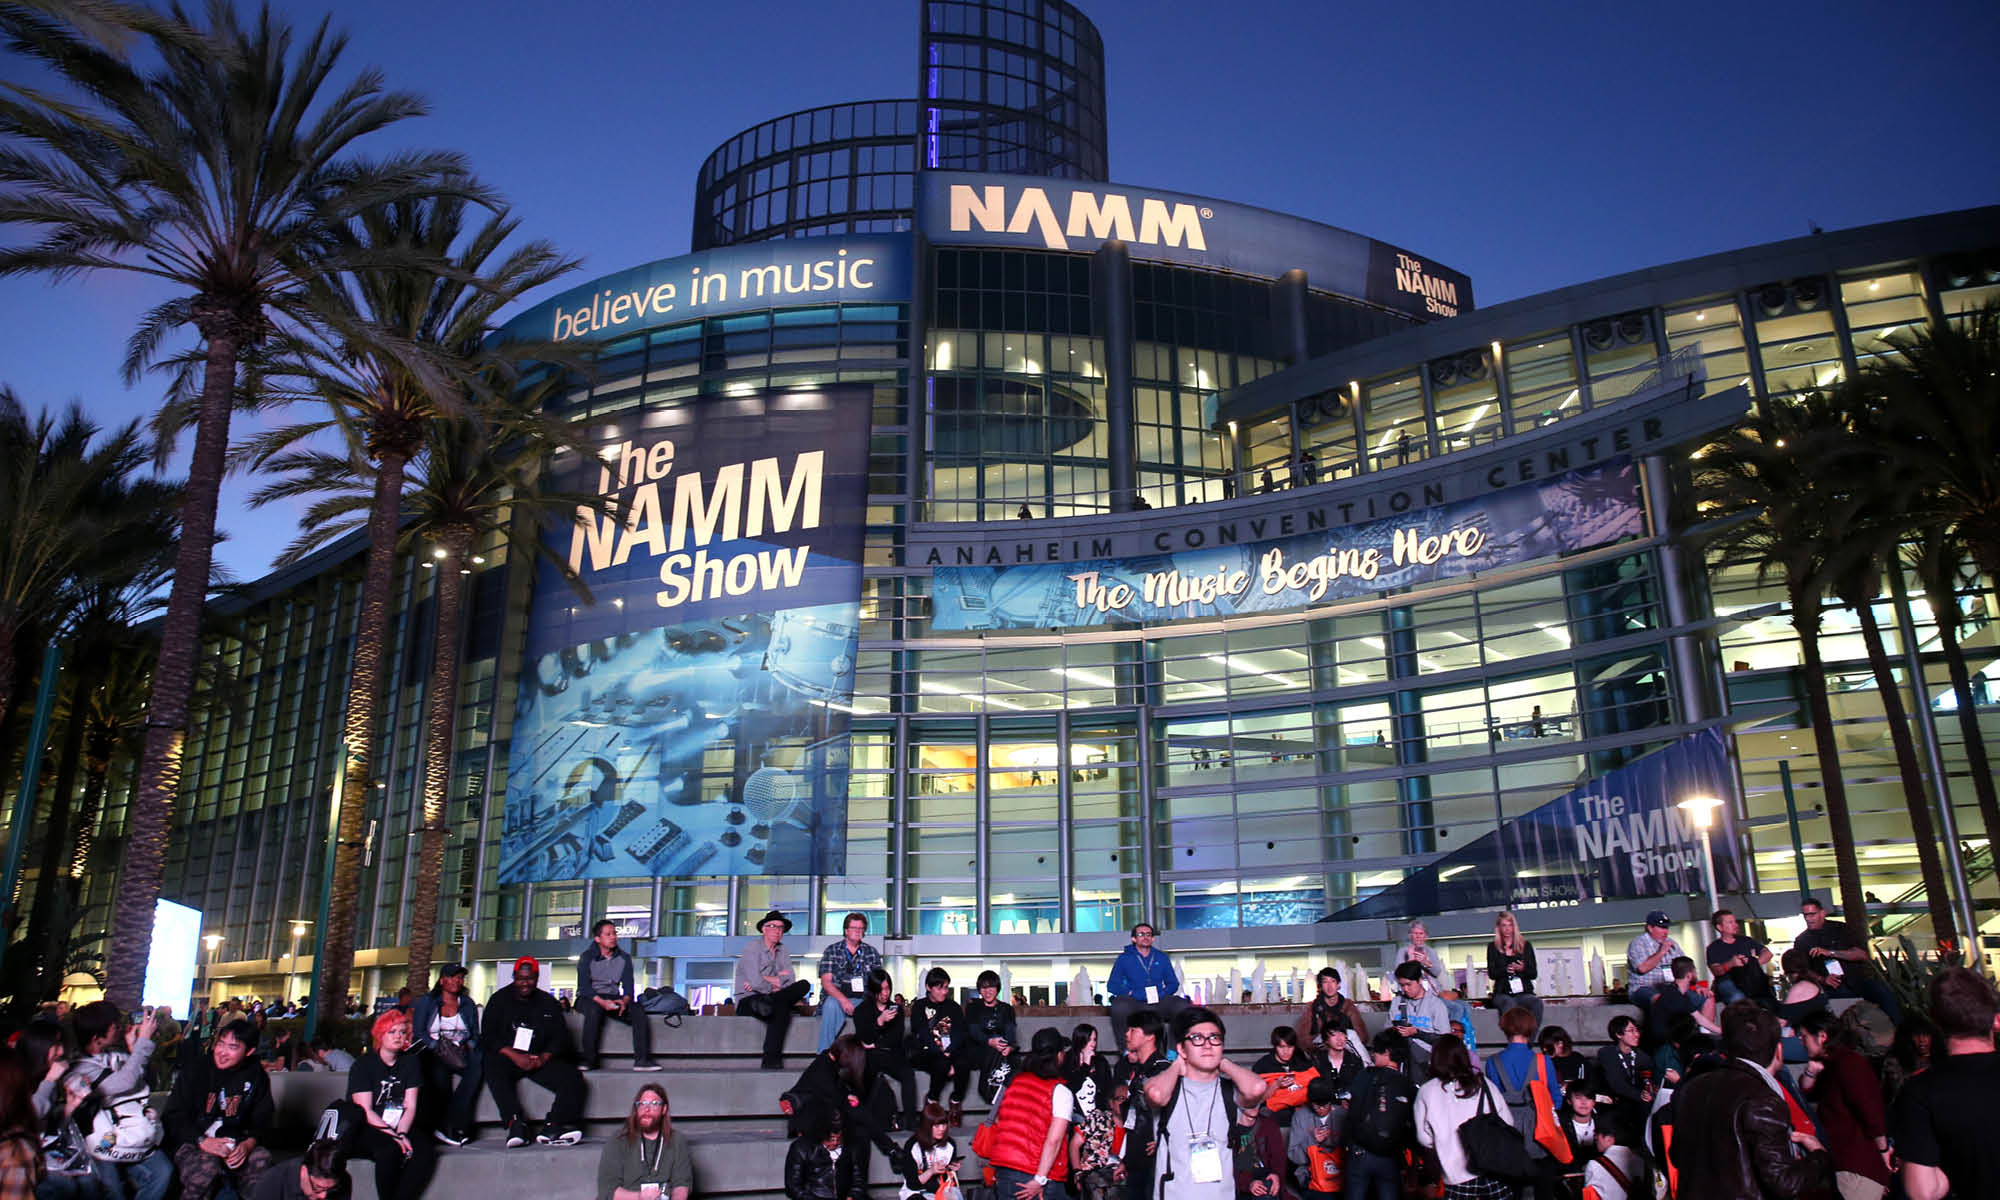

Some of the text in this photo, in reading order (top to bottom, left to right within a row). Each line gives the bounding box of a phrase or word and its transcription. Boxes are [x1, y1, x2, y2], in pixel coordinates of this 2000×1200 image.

[1395, 267, 1458, 306] NAMM
[1396, 253, 1423, 273] The
[553, 249, 875, 342] believe in music
[1426, 297, 1458, 318] Show
[597, 440, 675, 496] The
[926, 416, 1663, 566] ANAHEIM CONVENTION CENTER
[567, 450, 825, 577] NAMM
[656, 545, 811, 608] Show
[1066, 525, 1487, 613] The Music Begins Here
[1578, 794, 1625, 821] The
[1630, 847, 1700, 878] Show
